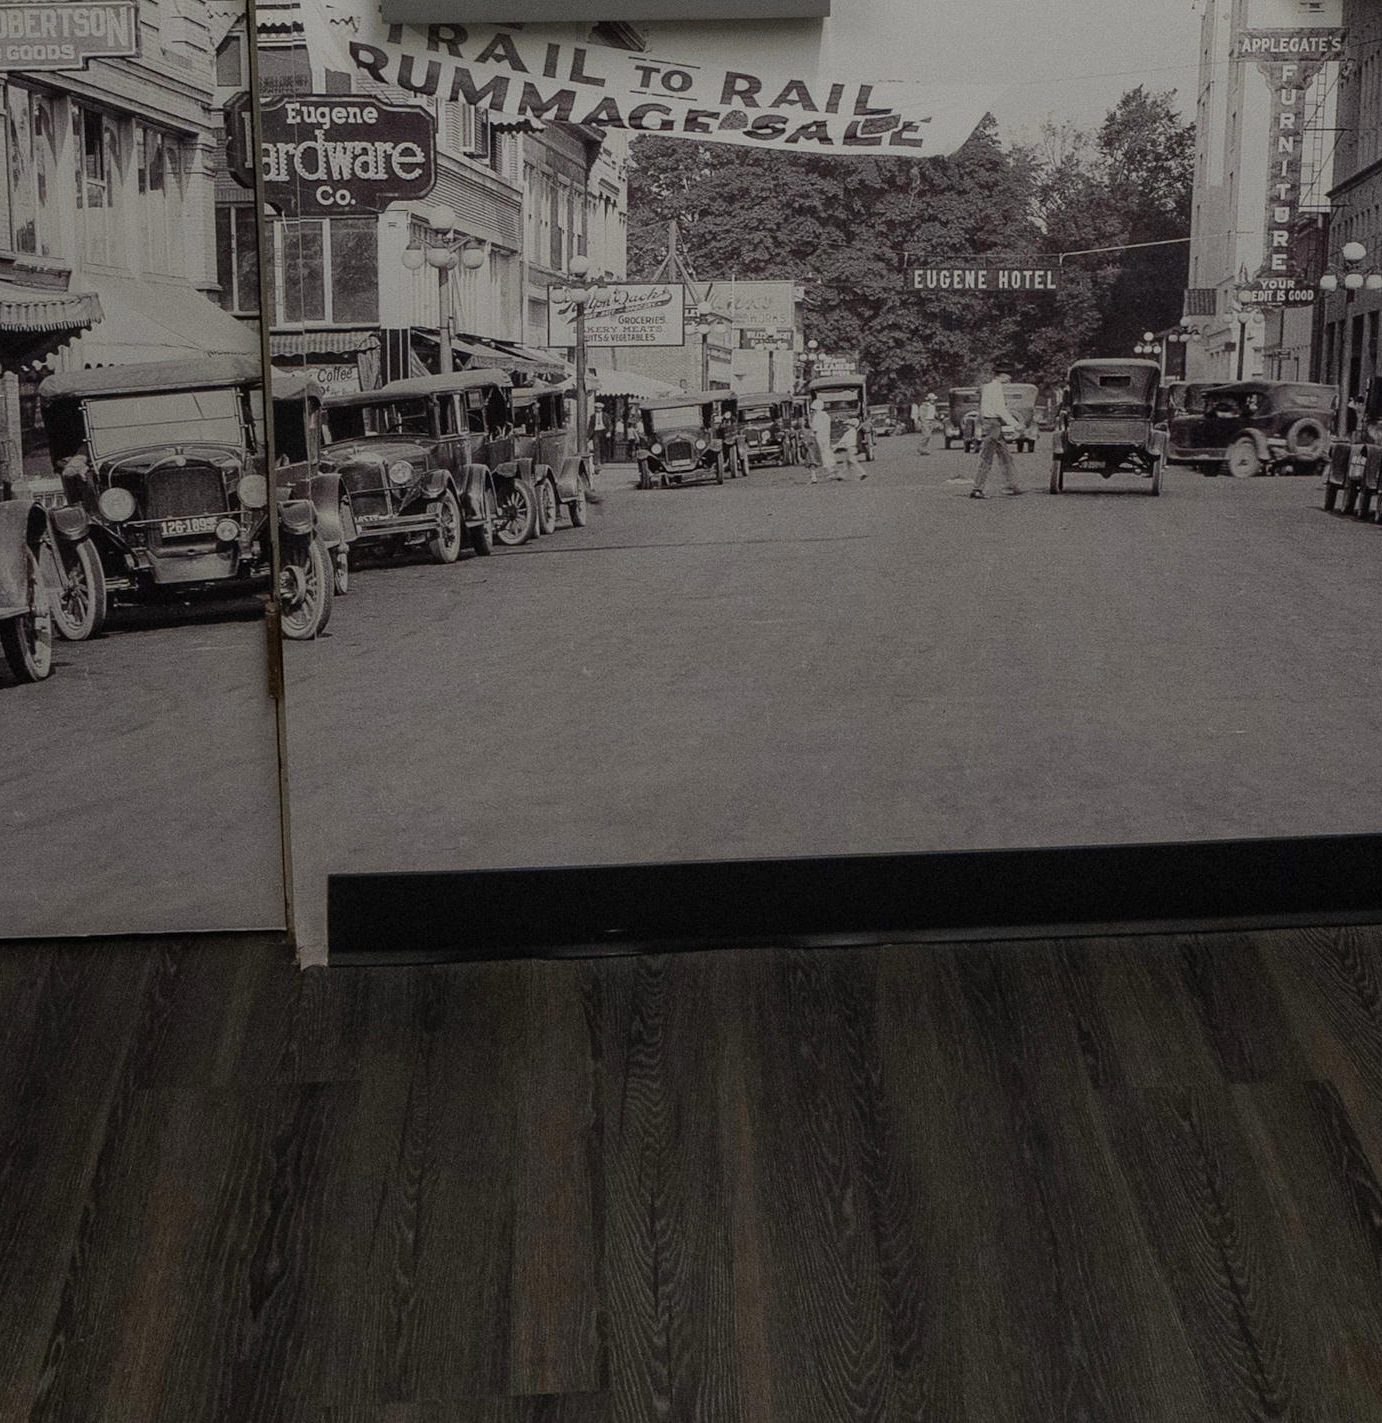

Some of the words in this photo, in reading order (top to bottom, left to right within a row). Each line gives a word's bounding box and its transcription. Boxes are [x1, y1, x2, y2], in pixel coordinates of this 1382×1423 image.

[6, 44, 76, 61] GOODS
[1241, 35, 1342, 54] APPLEGATE'S
[349, 41, 721, 134] RUMMAGE
[742, 114, 932, 147] SALE
[634, 65, 693, 93] TO
[720, 71, 894, 116] RAIL
[285, 102, 379, 129] Eugene
[1270, 64, 1299, 271] FURNITURE
[315, 185, 357, 207] Co.
[914, 269, 987, 289] EUGENE
[998, 270, 1057, 289] HOTEL
[1260, 279, 1296, 290] YOUR
[1250, 290, 1274, 302] EDIT
[1276, 290, 1286, 302] IS
[1288, 289, 1315, 301] GOOD
[317, 366, 354, 383] Coffee
